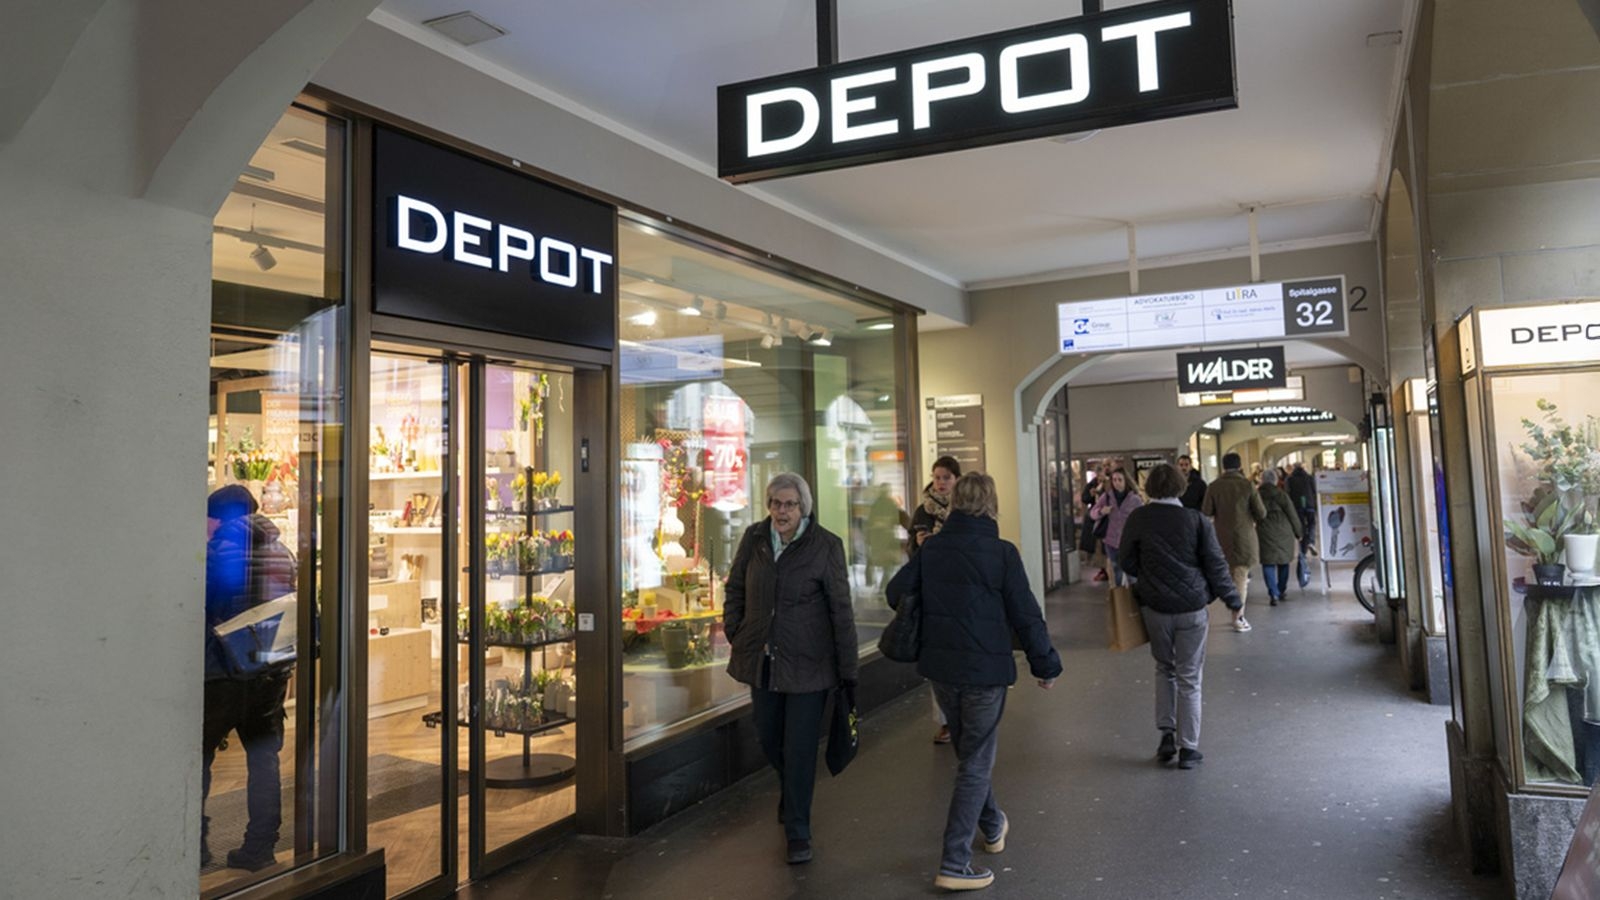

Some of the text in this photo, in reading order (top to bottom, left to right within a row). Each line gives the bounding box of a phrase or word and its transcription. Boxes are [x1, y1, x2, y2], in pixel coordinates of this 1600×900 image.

[745, 10, 1192, 158] DEPOT
[397, 194, 613, 295] DEPOT
[1288, 286, 1338, 298] Spitalgasse
[1295, 300, 1334, 327] 32
[1187, 357, 1274, 385] WALDER
